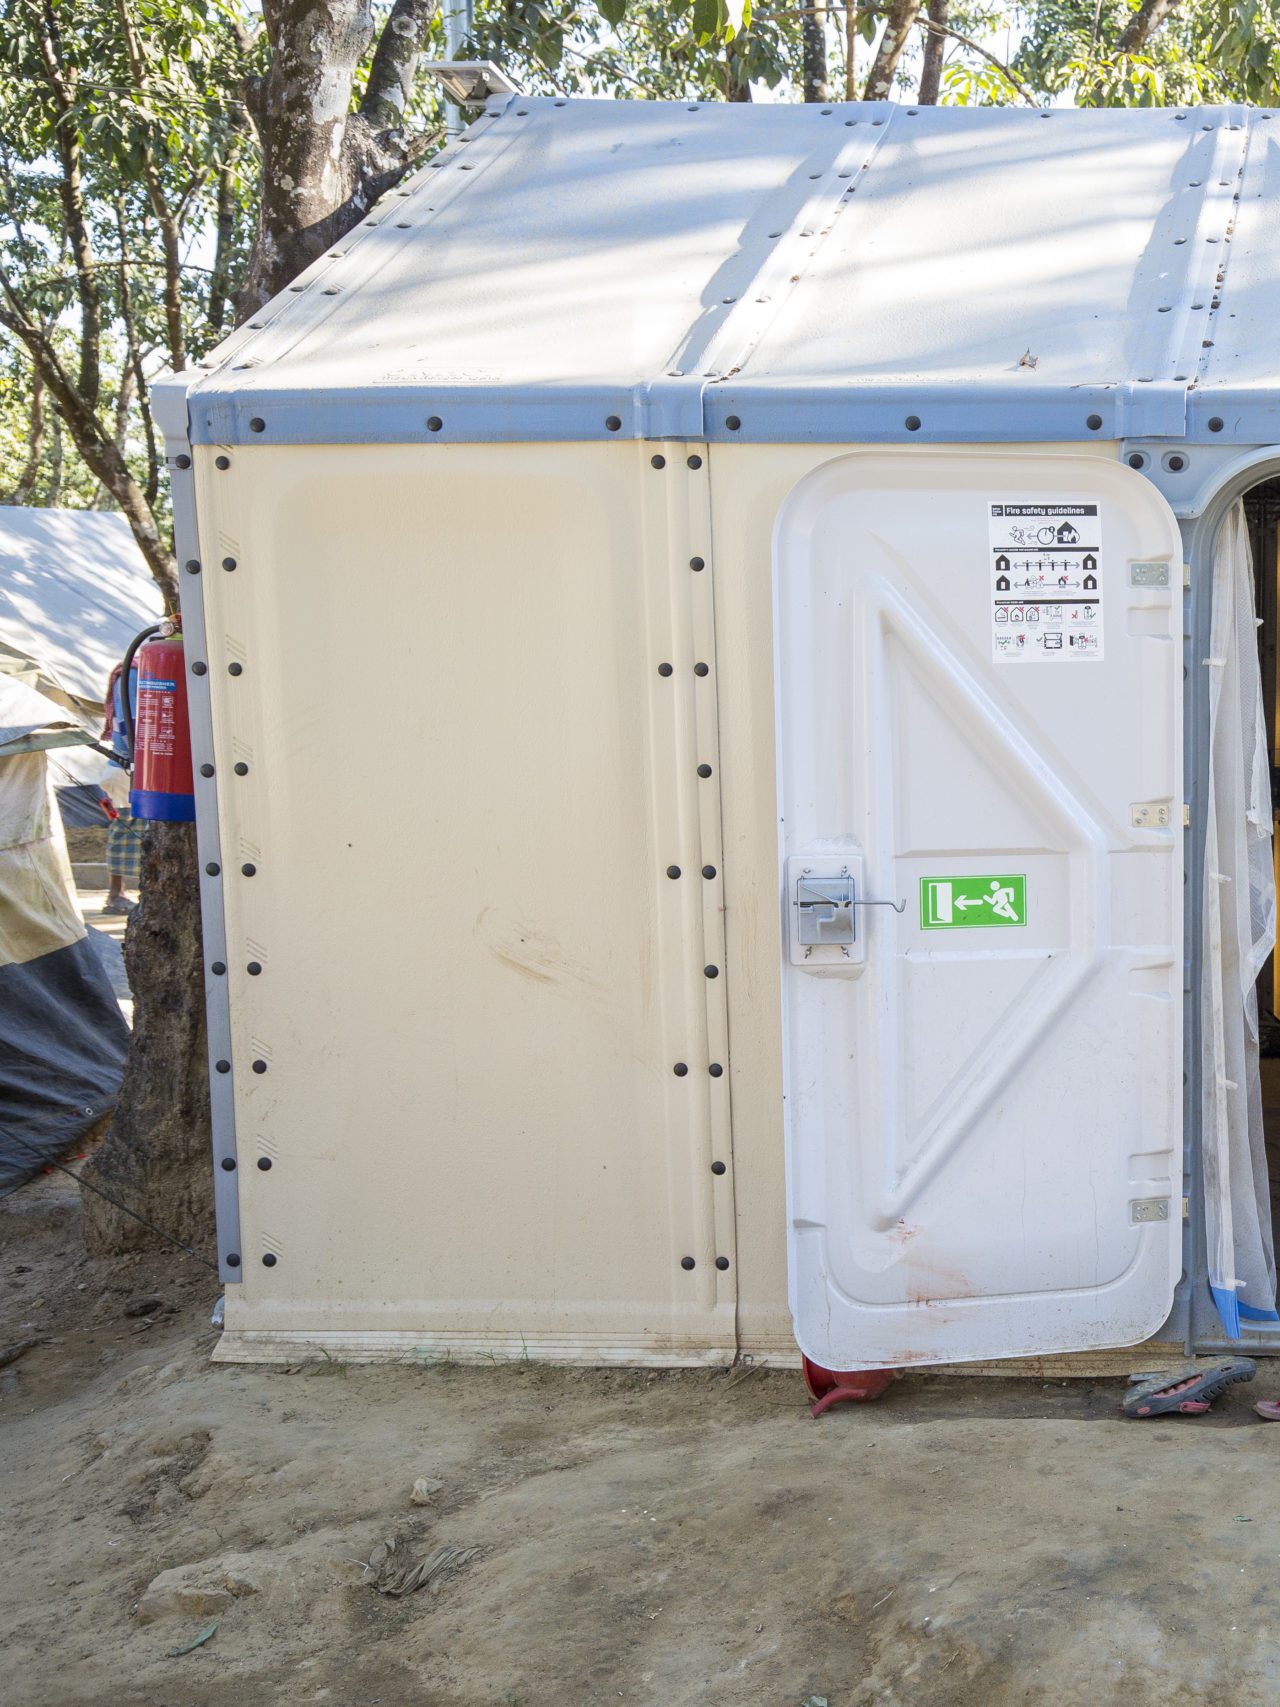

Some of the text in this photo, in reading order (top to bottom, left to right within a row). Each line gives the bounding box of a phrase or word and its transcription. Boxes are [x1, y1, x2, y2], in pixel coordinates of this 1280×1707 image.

[1006, 507, 1020, 515] Fire
[1022, 507, 1045, 516] safety
[1047, 507, 1085, 516] guidelines
